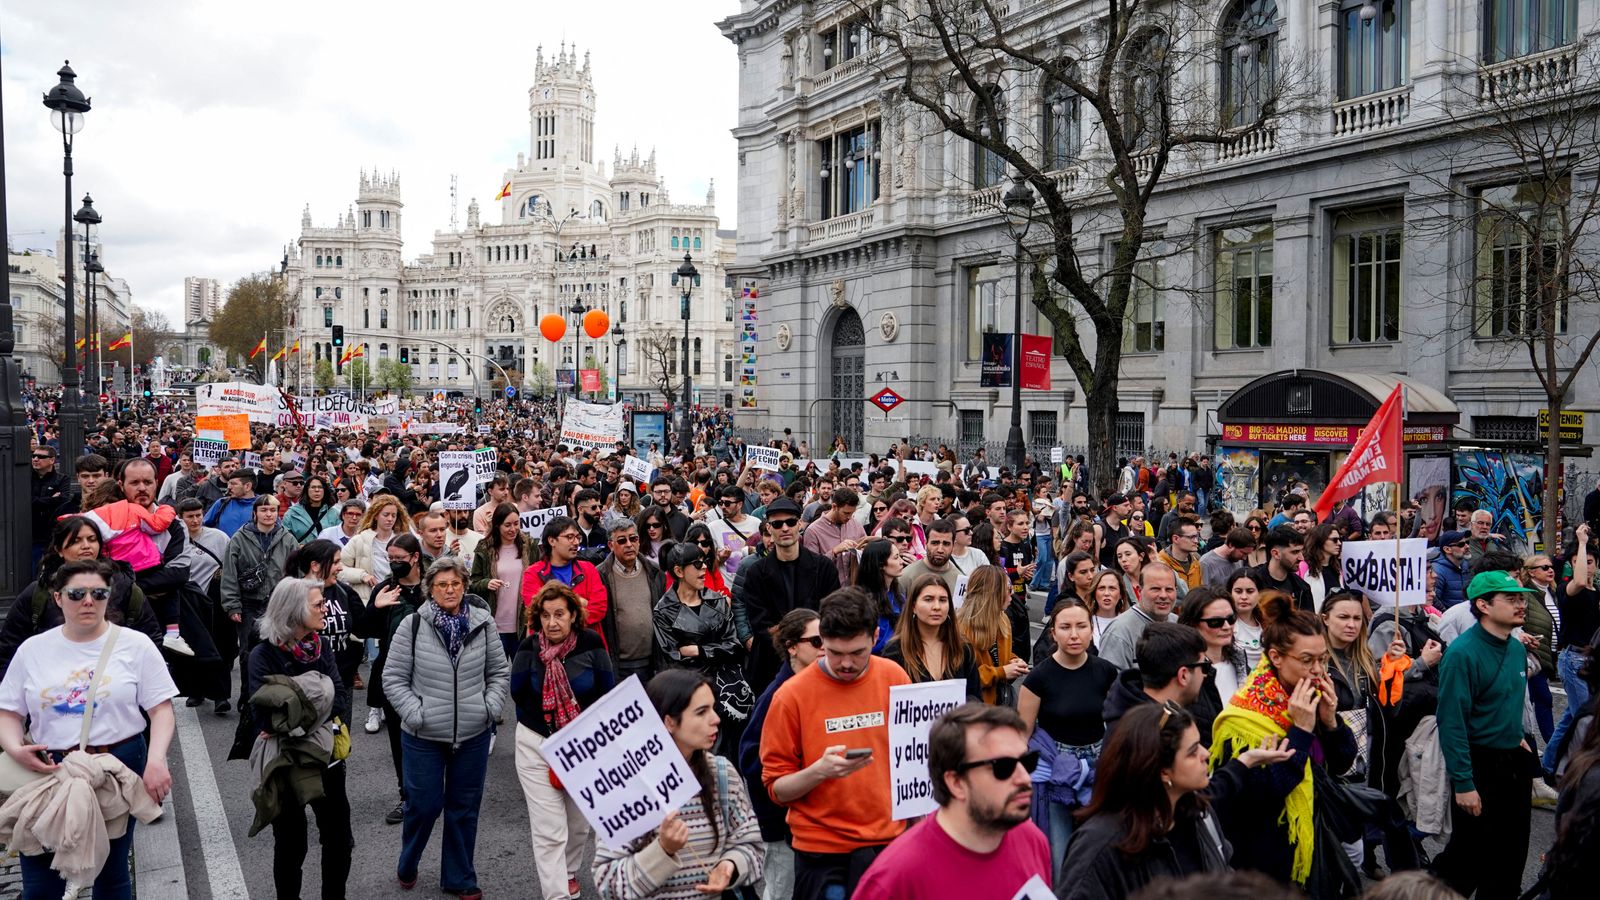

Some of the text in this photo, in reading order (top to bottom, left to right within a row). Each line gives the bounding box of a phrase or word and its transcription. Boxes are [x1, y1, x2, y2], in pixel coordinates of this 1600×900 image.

[1025, 355, 1045, 363] TEATRO
[1540, 413, 1583, 425] SOENIRS
[1276, 426, 1307, 435] MADRID
[1404, 433, 1444, 441] BUY TICKETS HERE
[195, 441, 228, 450] DERECHO
[195, 449, 227, 459] A TECHO
[748, 447, 779, 458] DERECHO
[757, 455, 778, 465] ECHO
[555, 700, 644, 772] ¡Hipotecas
[895, 745, 902, 768] y
[580, 734, 664, 810] y alquileres
[598, 762, 684, 838] justos, ya!
